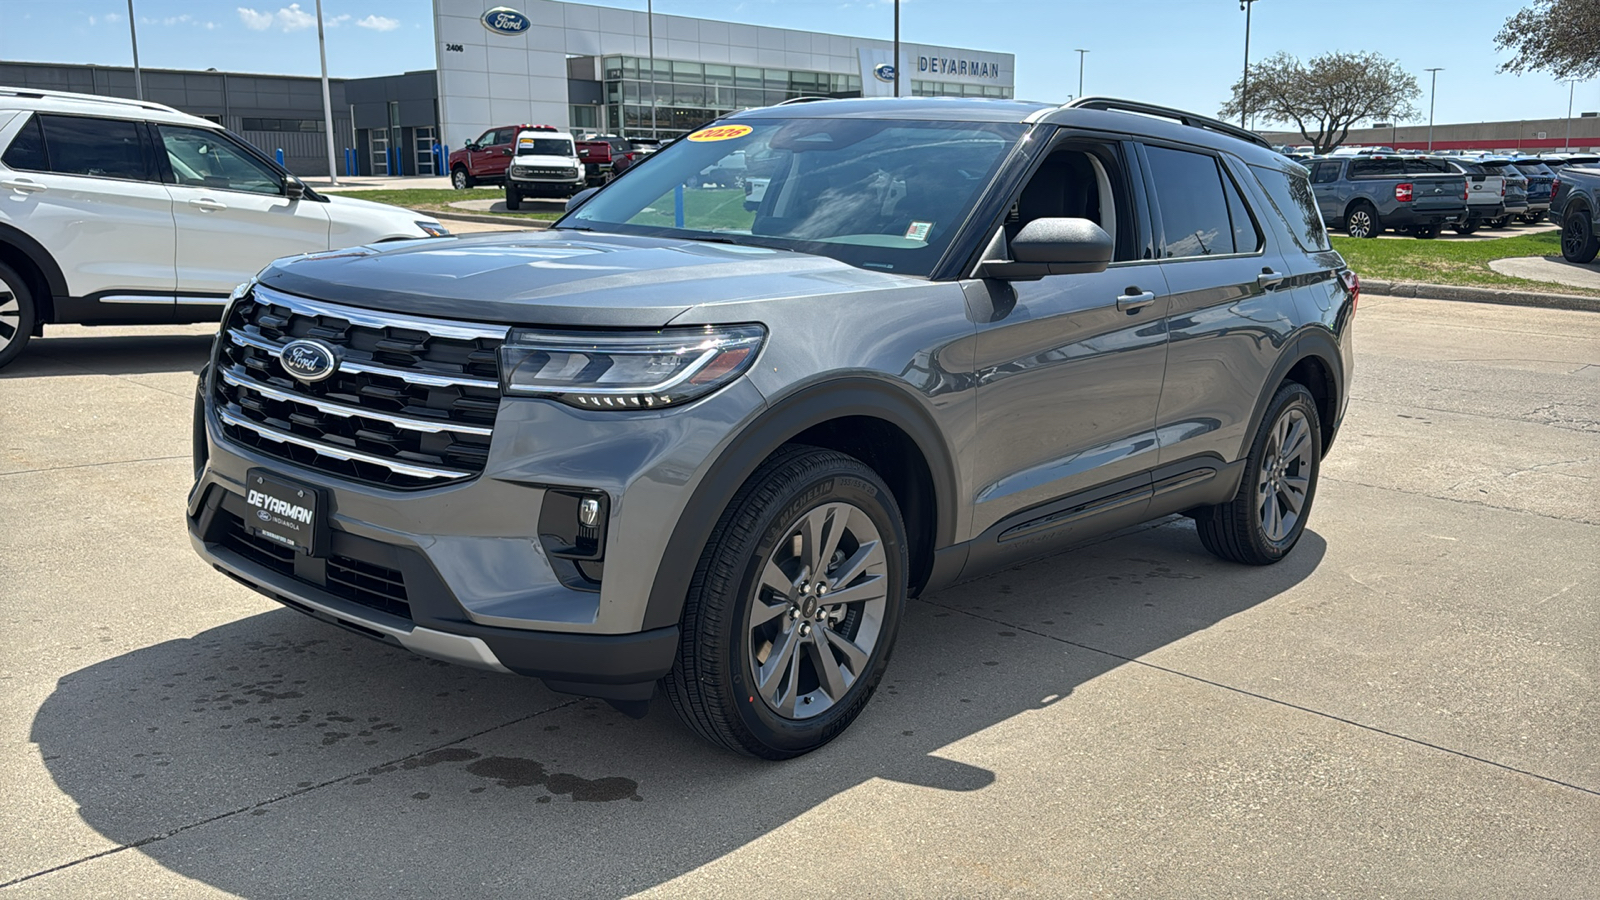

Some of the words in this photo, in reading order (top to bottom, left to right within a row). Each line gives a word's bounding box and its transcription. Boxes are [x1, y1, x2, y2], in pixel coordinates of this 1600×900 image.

[494, 13, 523, 30] Ford
[446, 43, 464, 53] 2406
[918, 56, 999, 79] DEYARMAN
[692, 128, 748, 139] 2026
[287, 346, 319, 371] Ford
[247, 489, 313, 525] DEYARMAN
[780, 480, 833, 526] MICHELIN
[272, 516, 300, 531] INDIANOLA
